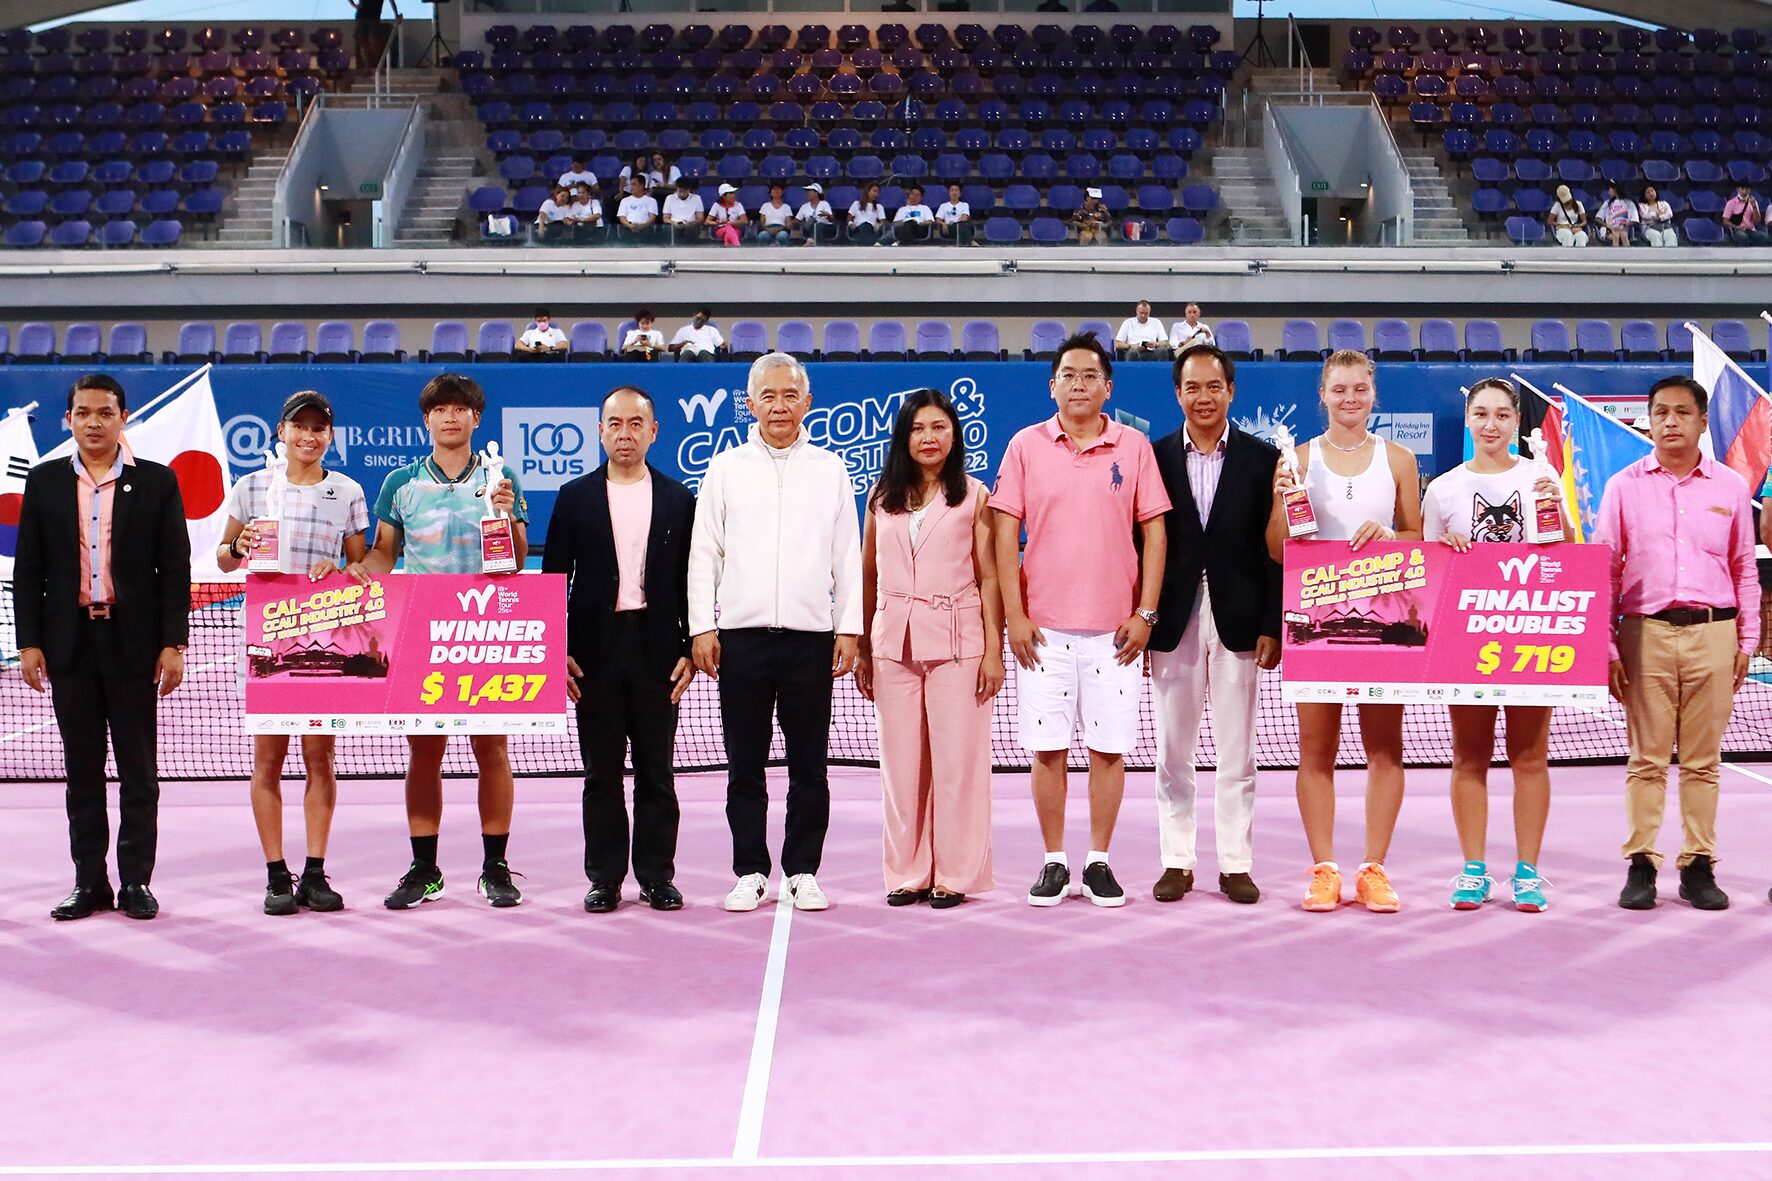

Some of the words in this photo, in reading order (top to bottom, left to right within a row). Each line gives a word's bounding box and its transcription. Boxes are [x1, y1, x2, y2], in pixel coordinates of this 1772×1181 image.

[951, 377, 985, 420] &
[347, 426, 435, 446] B.GRIM
[1394, 422, 1419, 430] Holiday
[1396, 430, 1427, 439] Resort
[519, 422, 584, 456] 100
[364, 455, 407, 466] SINCE
[522, 459, 584, 475] PLUS
[1301, 552, 1404, 586] CAL-COMP
[1409, 548, 1424, 566] &
[1300, 581, 1336, 599] CCAU
[1338, 569, 1402, 592] INDUSTRY
[1404, 565, 1426, 579] 4.0
[263, 585, 364, 619] CAL-COMP
[369, 581, 384, 598] &
[1457, 589, 1596, 612] FINALIST
[262, 615, 297, 632] CCAU
[300, 602, 362, 625] INDUSTRY
[364, 598, 385, 611] 4.0
[277, 626, 308, 639] WORLD
[340, 614, 364, 626] TOUR
[1466, 614, 1586, 635] DOUBLES
[429, 620, 546, 642] WINNER
[429, 645, 547, 664] DOUBLES
[1476, 641, 1502, 675] $
[1511, 645, 1576, 673] 719
[420, 671, 445, 705] $
[457, 674, 547, 706] 1,437
